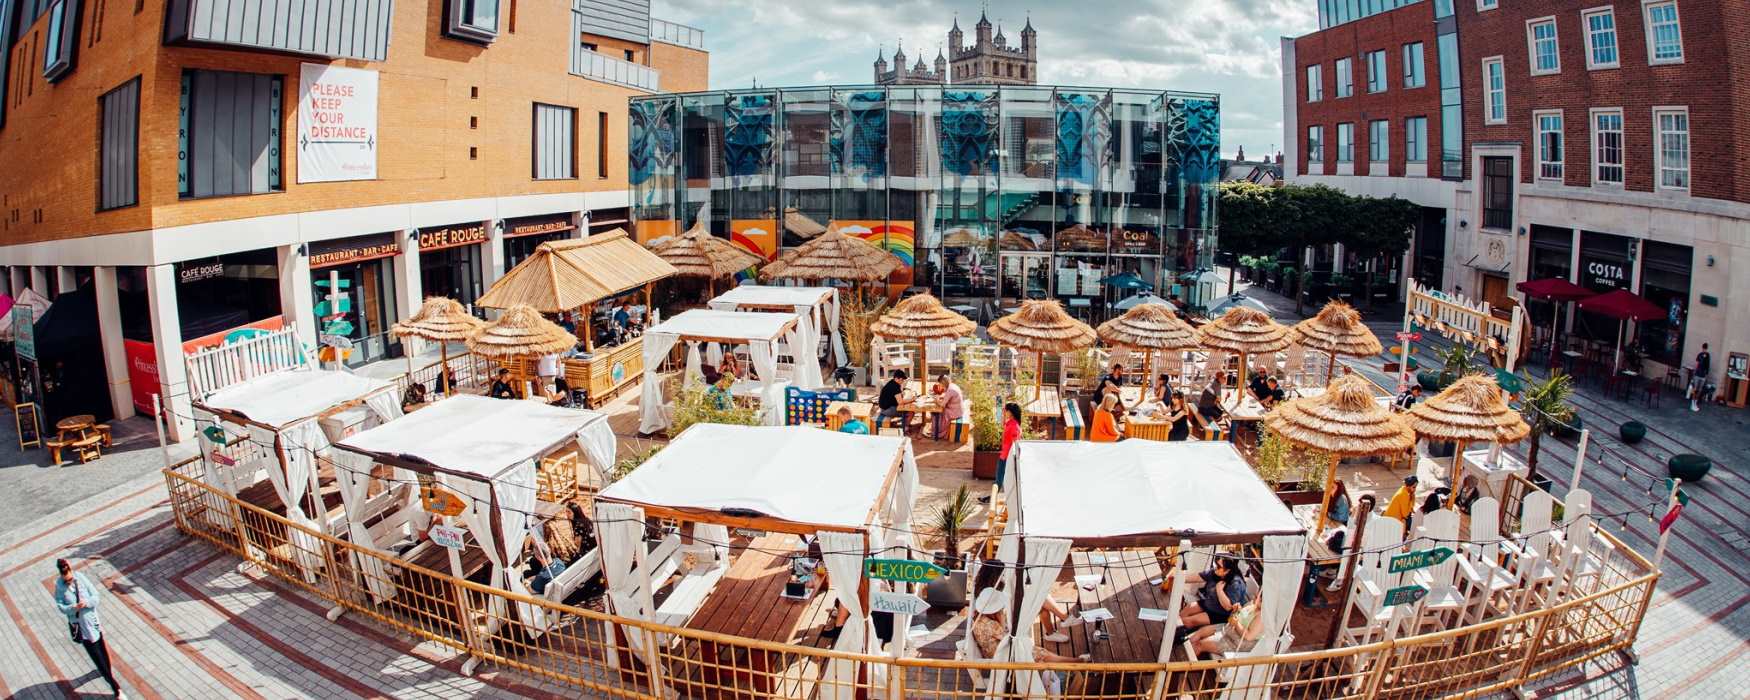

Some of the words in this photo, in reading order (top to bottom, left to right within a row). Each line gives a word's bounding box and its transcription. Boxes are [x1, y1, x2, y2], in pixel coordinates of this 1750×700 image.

[311, 84, 354, 97] PLEASE
[312, 98, 342, 110] KEEP
[312, 112, 344, 124] YOUR
[178, 84, 188, 183] BYRON
[271, 88, 279, 176] BYRON
[311, 126, 366, 139] DISTANCE
[420, 229, 448, 248] CAFÉ
[451, 226, 485, 244] ROUGE
[1123, 230, 1148, 241] Coal
[310, 249, 358, 265] RESTAURANT
[363, 247, 378, 257] BAR
[1588, 262, 1623, 280] COSTA
[1595, 277, 1616, 287] COFFEE
[1392, 555, 1424, 571] MIAMI
